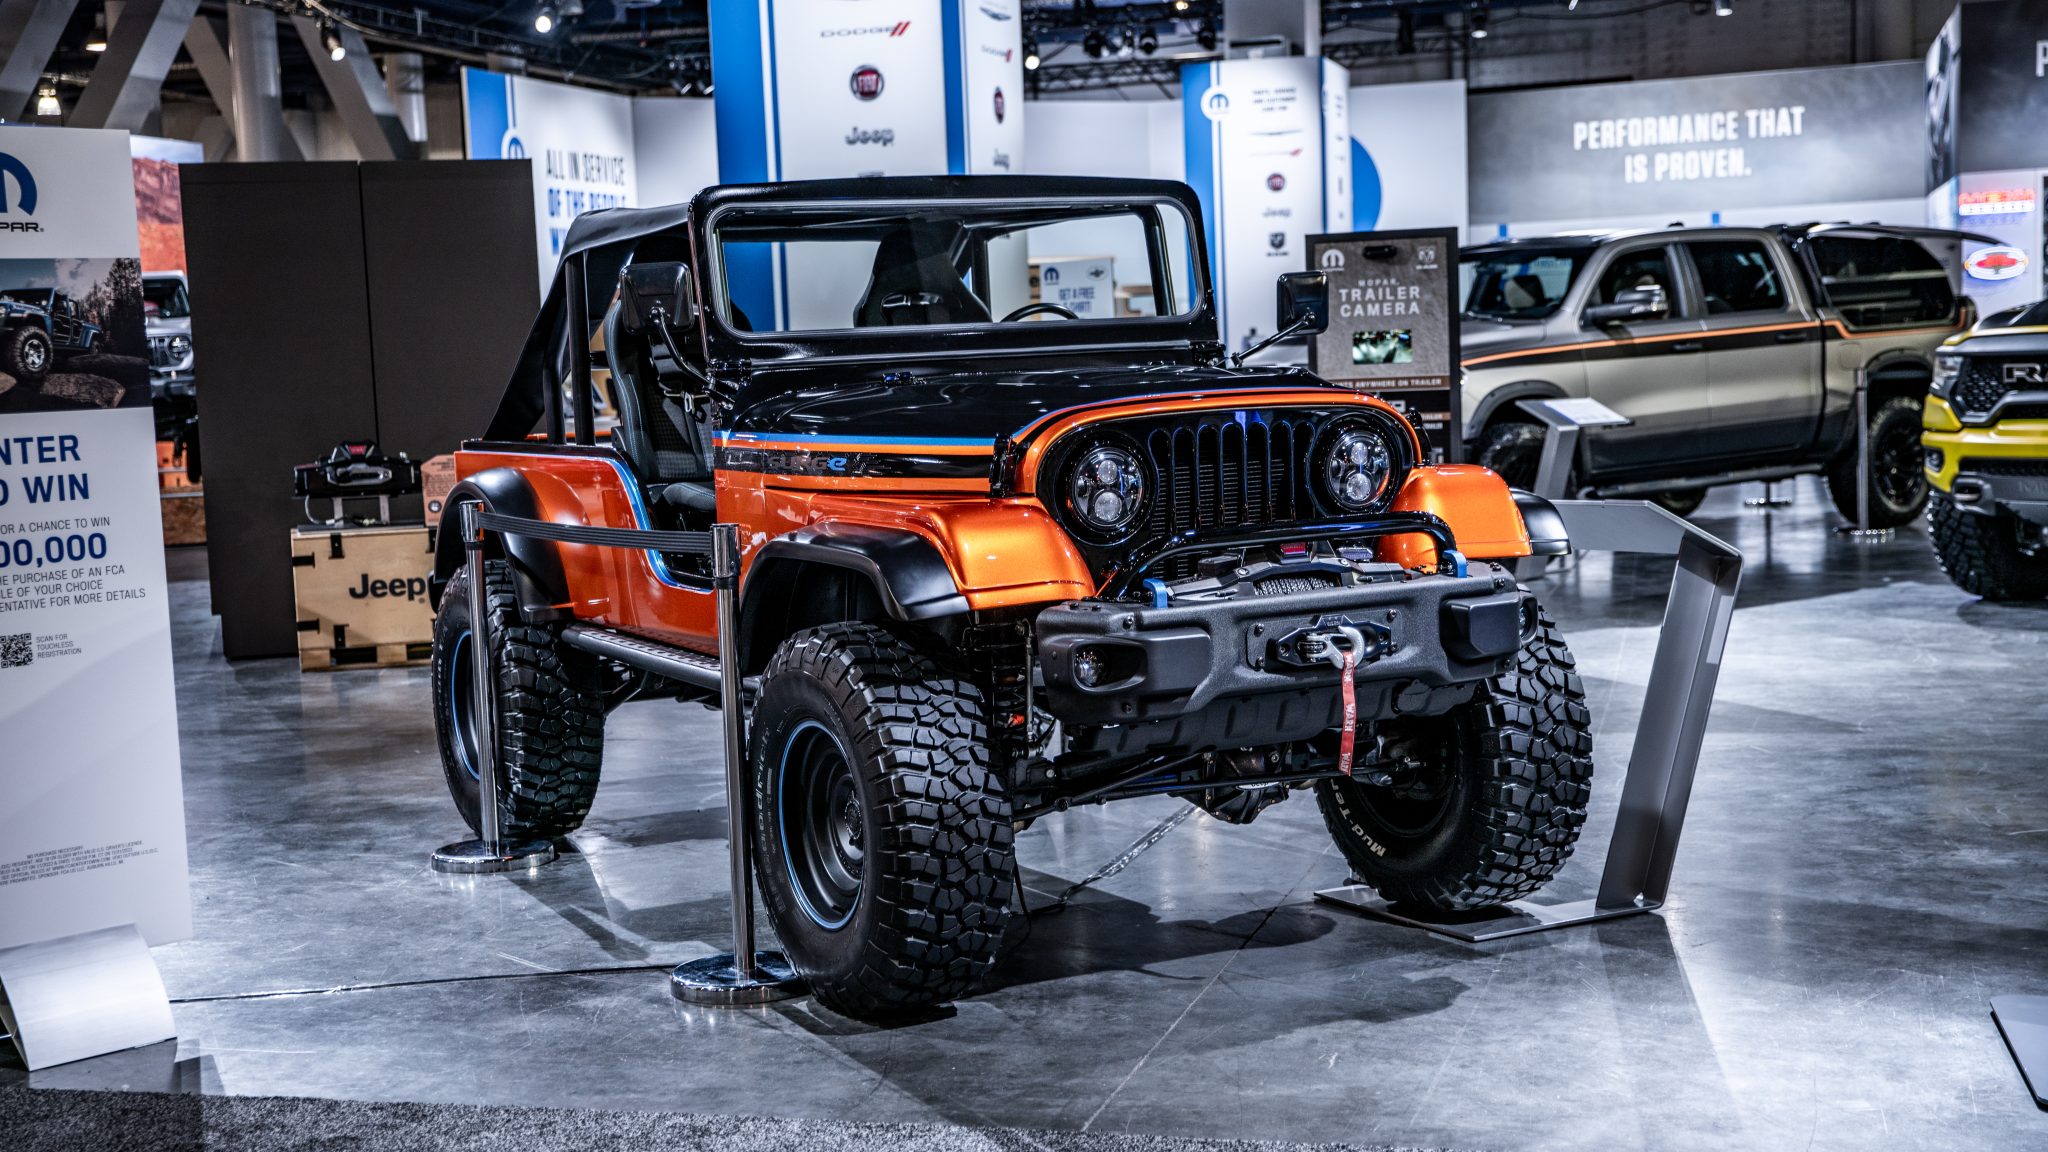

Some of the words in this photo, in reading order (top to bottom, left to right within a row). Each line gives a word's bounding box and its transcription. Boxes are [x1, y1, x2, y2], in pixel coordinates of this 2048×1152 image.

[845, 126, 895, 147] Jeep
[1573, 111, 1739, 150] PERFORMANCE
[1744, 106, 1805, 139] THAT
[583, 152, 625, 186] SERVICE
[1624, 154, 1649, 184] IS
[1654, 147, 1753, 182] PROVEN.
[1339, 286, 1421, 302] TRAILER
[1340, 301, 1421, 318] CAMERA
[1410, 378, 1442, 386] TRAILER
[2003, 363, 2048, 383] R
[22, 473, 90, 504] WIN
[19, 522, 26, 533] A
[29, 519, 71, 533] CHANCE
[75, 518, 88, 529] TO
[92, 516, 111, 528] WIN
[13, 571, 67, 585] PURCHASE
[72, 568, 85, 580] OF
[88, 567, 102, 578] AN
[105, 564, 125, 577] FCA
[17, 586, 30, 598] OF
[34, 583, 62, 596] YOUR
[66, 579, 103, 592] CHOICE
[348, 573, 426, 601] Jeep
[50, 595, 70, 607] FOR
[74, 593, 102, 605] MORE
[106, 588, 146, 602] DETAILS
[36, 635, 54, 643] SCAN
[55, 633, 68, 642] FOR
[36, 641, 74, 651] TOUCHLESS
[37, 648, 82, 659] REGISTRATION
[1345, 704, 1356, 732] WARN
